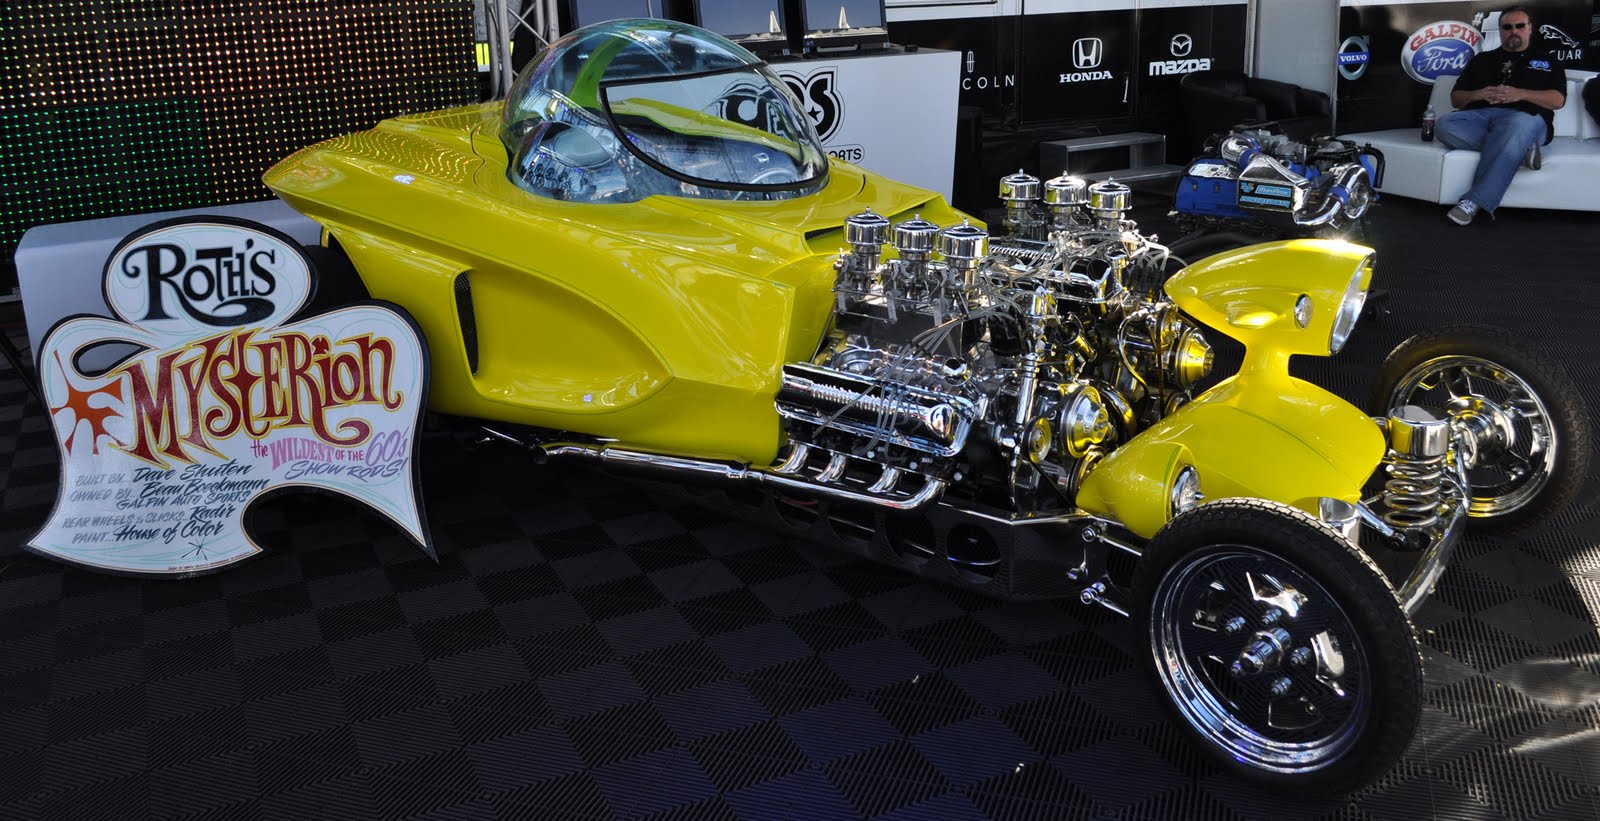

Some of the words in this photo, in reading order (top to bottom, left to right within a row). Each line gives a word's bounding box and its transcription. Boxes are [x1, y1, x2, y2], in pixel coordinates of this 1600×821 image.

[1410, 24, 1480, 51] GALPIN
[1340, 54, 1367, 62] VOLVO
[1417, 46, 1469, 72] Ford
[962, 74, 1015, 90] COLN
[1059, 70, 1113, 83] HONDA
[250, 439, 268, 458] the
[270, 437, 335, 471] WILDEST
[335, 450, 345, 460] OF
[347, 450, 364, 461] THE
[76, 474, 107, 487] BUILT
[133, 467, 176, 482] Dave
[180, 458, 253, 481] Shuten
[285, 460, 345, 480] SHOW
[346, 457, 409, 483] RODS!
[70, 489, 112, 502] OWNED
[139, 481, 183, 498] Beau
[183, 476, 270, 497] Boeckmann
[115, 496, 170, 510] GALPIN
[170, 494, 203, 507] AUTO
[204, 489, 251, 504] SPORTS
[62, 517, 91, 528] REAR
[91, 514, 134, 527] WHEELS
[188, 503, 236, 524] Radir
[113, 525, 162, 542] House
[162, 522, 181, 544] of
[180, 519, 225, 539] Color
